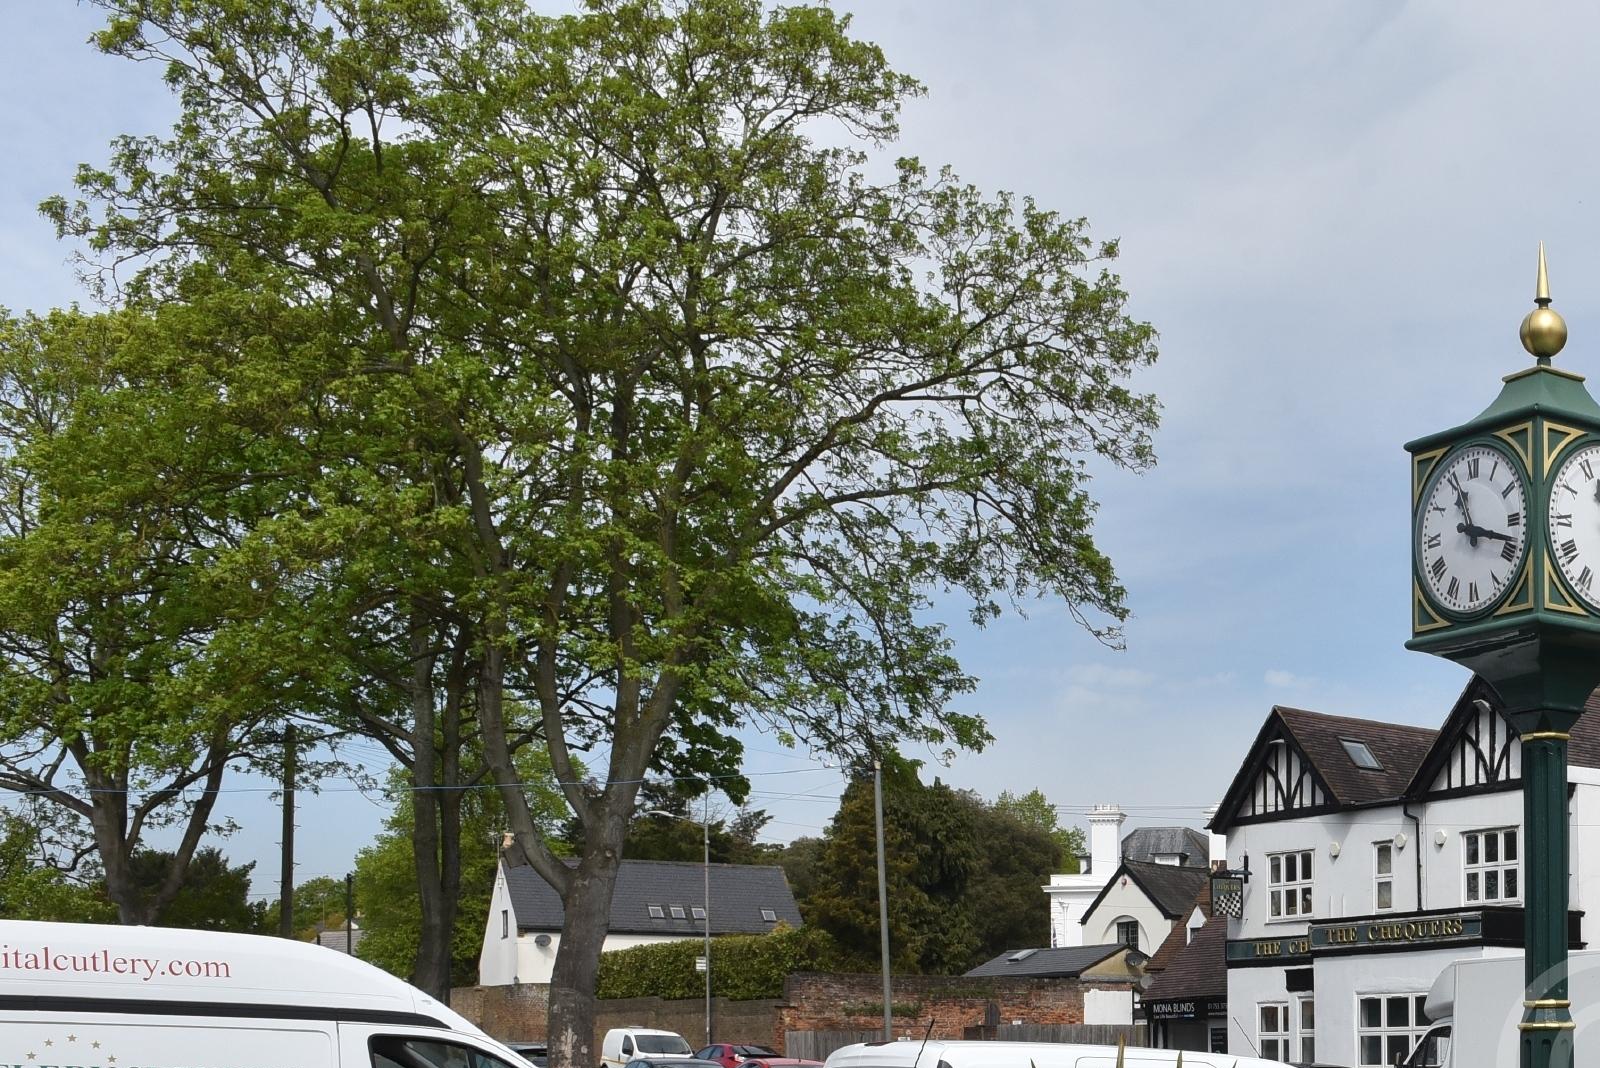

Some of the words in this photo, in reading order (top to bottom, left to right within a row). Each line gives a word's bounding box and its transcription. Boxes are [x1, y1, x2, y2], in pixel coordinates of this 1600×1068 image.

[1467, 458, 1480, 481] XII
[1489, 461, 1498, 481] I
[1579, 459, 1594, 483] XI
[1501, 480, 1517, 500] II
[1562, 480, 1577, 500] X
[1433, 501, 1446, 518] X
[1508, 512, 1520, 527] III
[1556, 512, 1572, 528] IX
[1428, 532, 1441, 549] IX
[1561, 539, 1579, 565] VIII
[1431, 556, 1448, 582] VIII
[1578, 565, 1594, 590] VII
[1447, 576, 1460, 600] VII
[1469, 580, 1480, 602] VI
[1325, 927, 1358, 945] THE
[1368, 918, 1463, 941] CHEQUERS
[1254, 941, 1281, 956] THE
[2, 945, 231, 981] italcutlery.com
[1153, 1003, 1172, 1013] MONA
[1173, 1002, 1195, 1012] BLINDS
